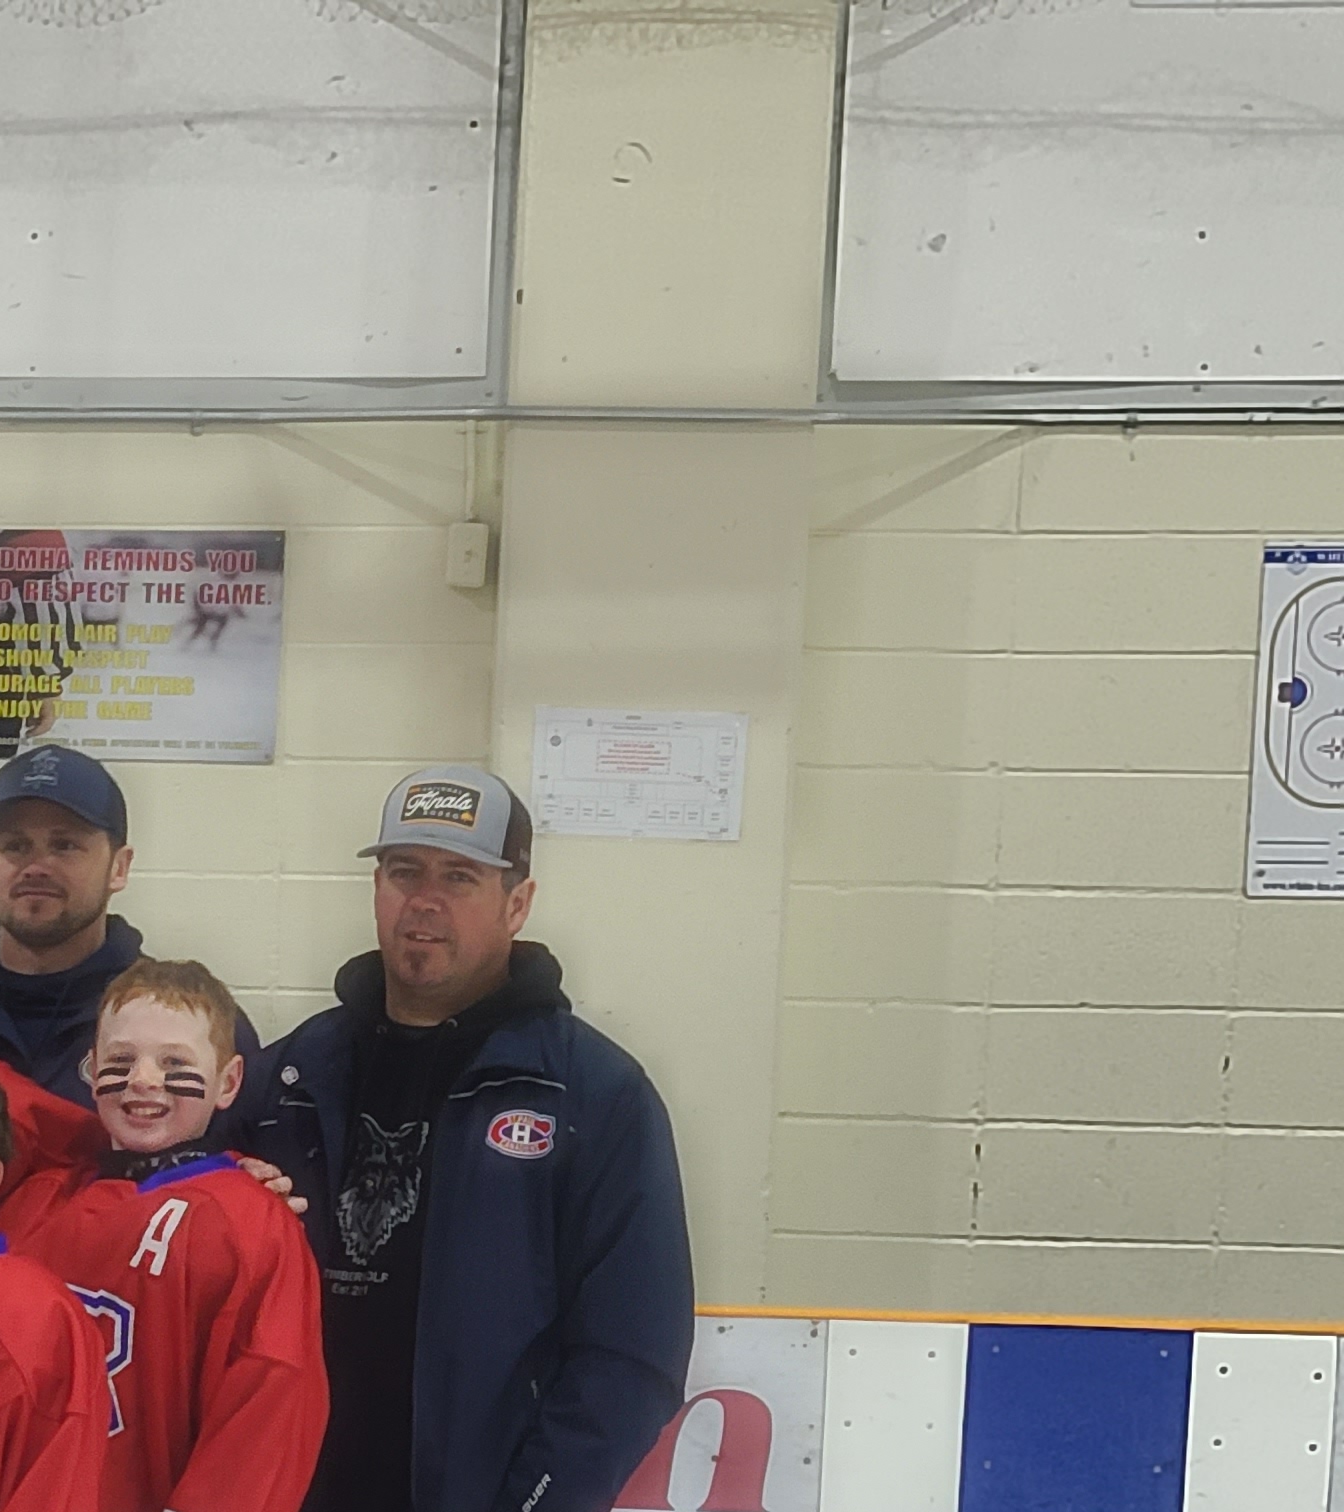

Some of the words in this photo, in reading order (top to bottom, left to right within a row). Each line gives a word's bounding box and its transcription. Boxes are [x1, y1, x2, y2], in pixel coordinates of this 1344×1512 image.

[83, 548, 195, 573] REMINDS
[205, 550, 257, 574] YOU
[23, 581, 128, 603] RESPECT
[142, 582, 186, 605] THE
[198, 582, 273, 606] GAME.
[73, 623, 118, 643] FAIR
[125, 624, 175, 644] PLAY
[62, 650, 150, 669] RESPECT
[68, 675, 103, 695] ALL
[109, 675, 196, 696] PLAYERS
[52, 700, 89, 719] THE
[96, 701, 154, 720] GAME
[128, 1198, 189, 1277] A
